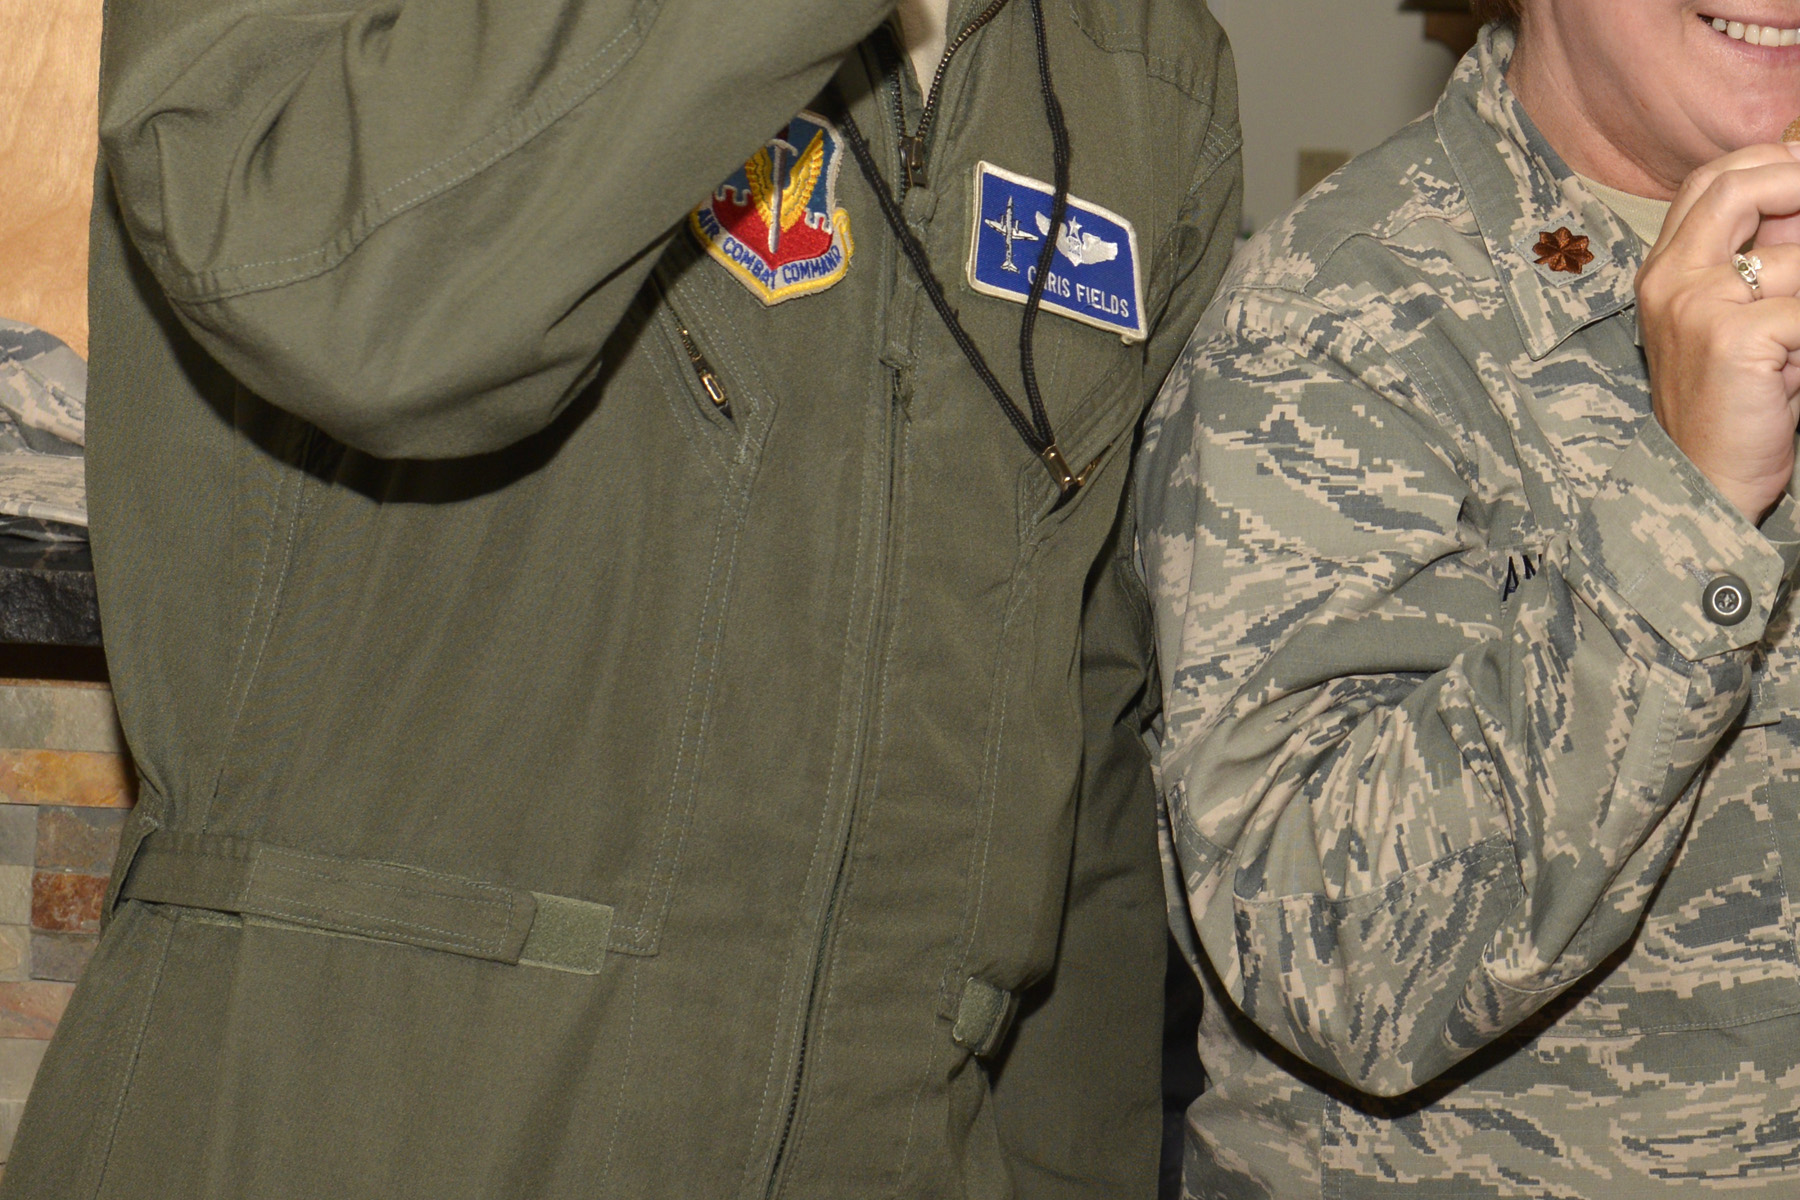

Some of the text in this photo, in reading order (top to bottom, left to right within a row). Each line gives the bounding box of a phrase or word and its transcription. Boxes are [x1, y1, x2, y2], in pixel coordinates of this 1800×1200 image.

[697, 208, 842, 290] AIR COMBAT COMMAND
[1075, 285, 1129, 318] FIELDS
